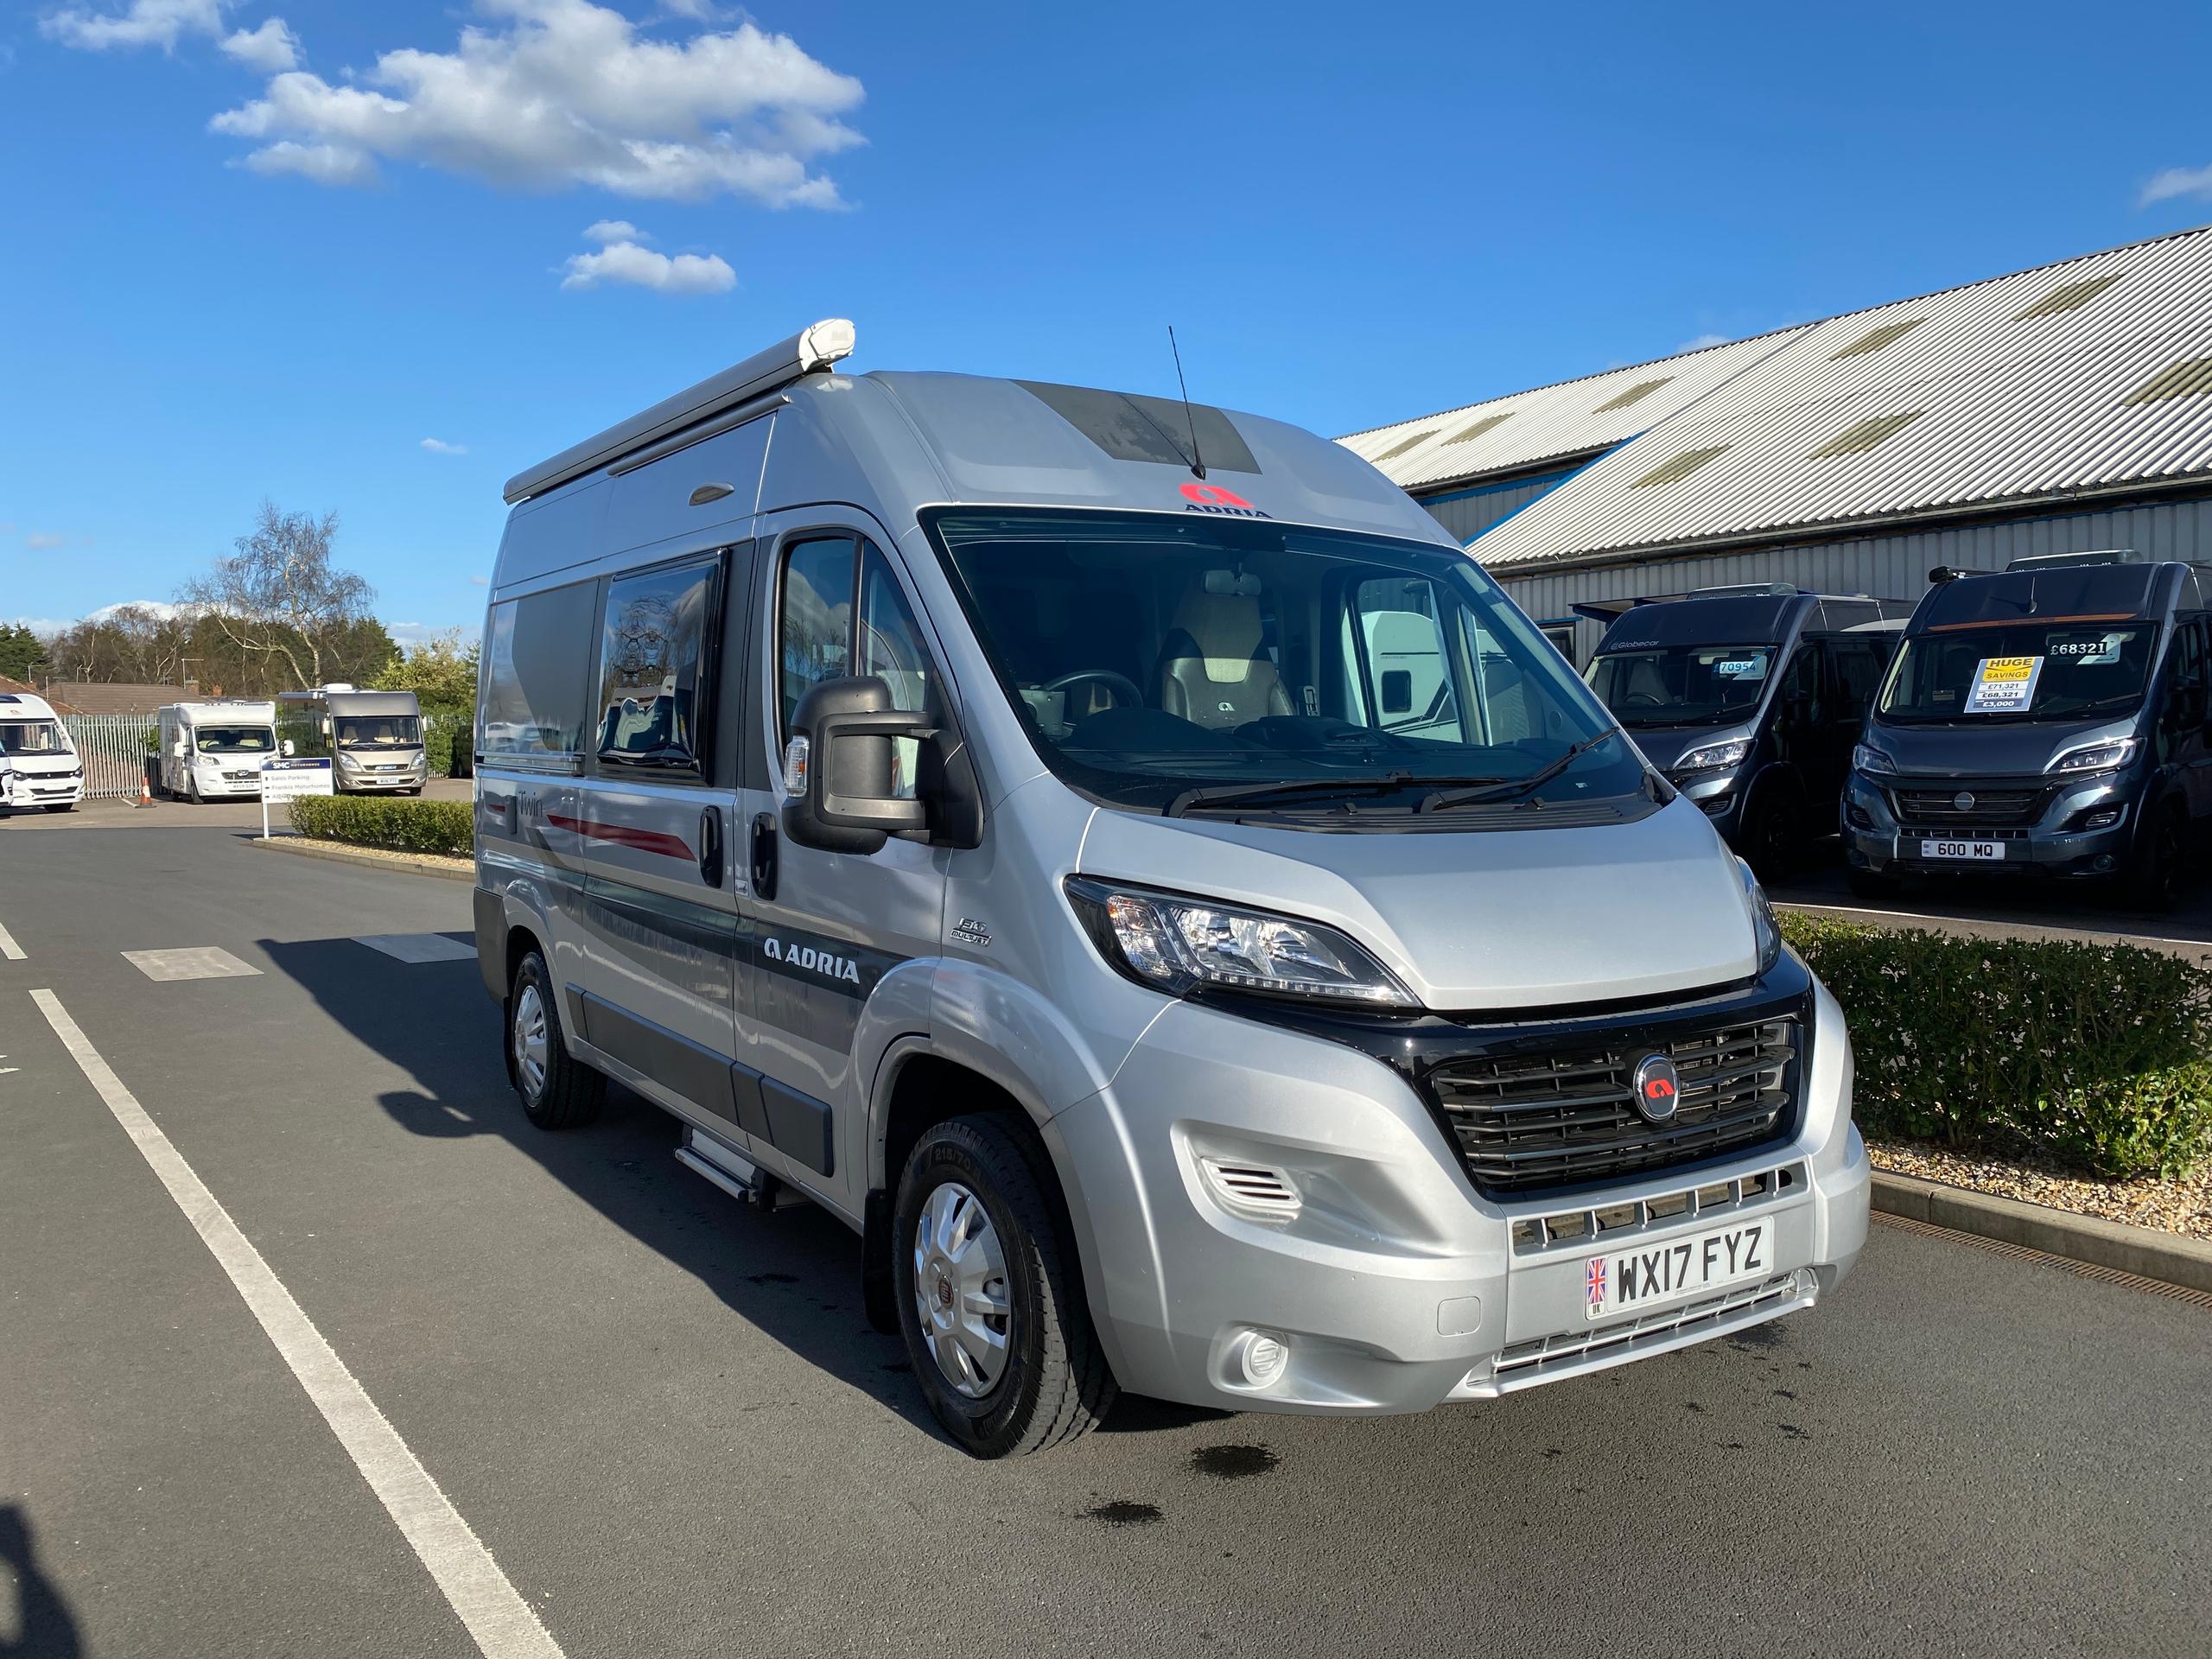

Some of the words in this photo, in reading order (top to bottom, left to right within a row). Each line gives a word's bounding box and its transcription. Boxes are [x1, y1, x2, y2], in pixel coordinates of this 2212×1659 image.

[1185, 504, 1274, 519] ADRIA
[1618, 640, 1660, 649] Globecar
[2050, 643, 2105, 655] £68321
[1713, 661, 1757, 674] £70954
[1989, 658, 2033, 668] HUGE
[518, 790, 543, 817] Twin
[1938, 842, 1967, 856] 600
[1974, 843, 1993, 857] MQ
[950, 929, 991, 947] MULTIJET
[785, 944, 861, 984] ADRIA
[1618, 1243, 1693, 1304] WX17
[1702, 1226, 1763, 1282] FYZ
[1592, 1303, 1601, 1314] UK
